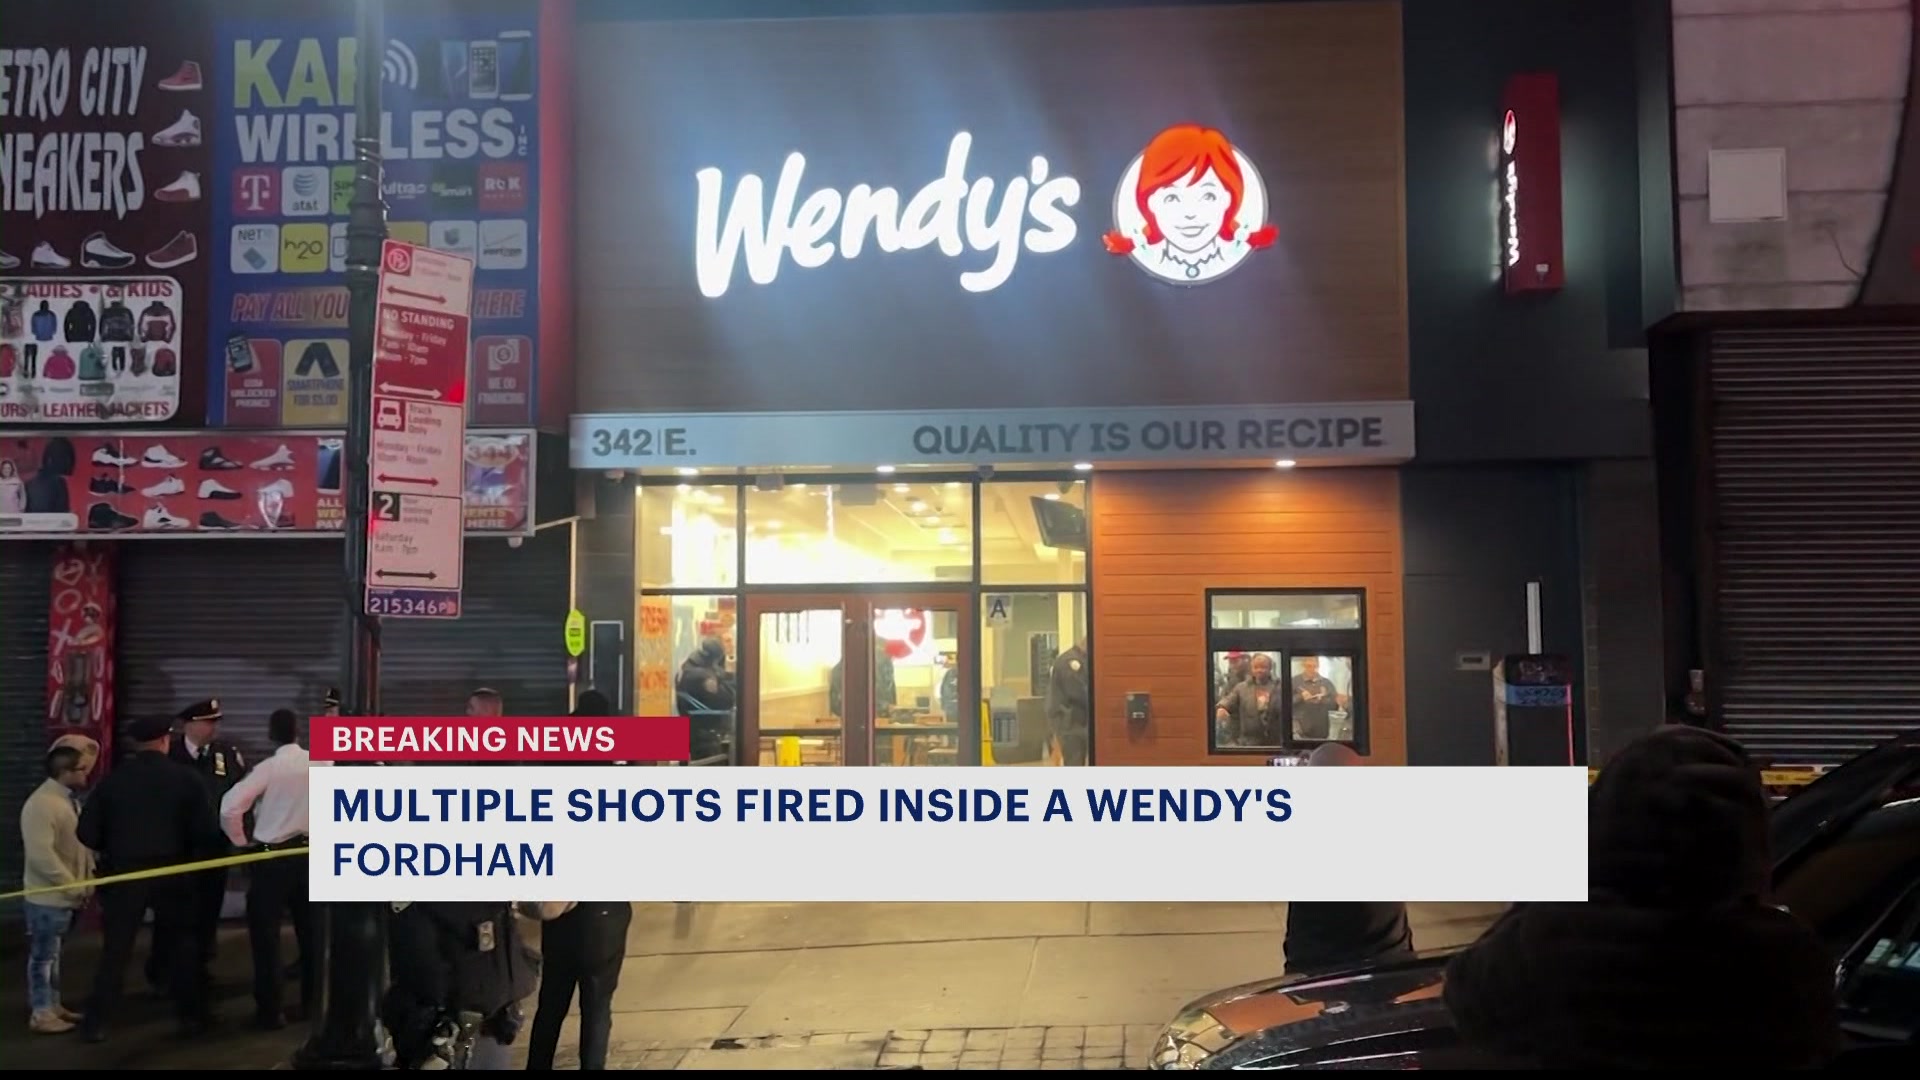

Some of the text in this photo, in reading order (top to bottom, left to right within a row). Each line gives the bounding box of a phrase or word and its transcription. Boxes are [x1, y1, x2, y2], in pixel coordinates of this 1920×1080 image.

[80, 46, 147, 117] CITY
[696, 131, 1080, 298] Wendy's
[128, 281, 173, 297] KIDS
[313, 292, 351, 320] YOU
[382, 308, 455, 330] NO STANDING
[43, 401, 106, 418] LEATHE
[591, 428, 653, 457] 342
[912, 417, 1383, 455] QUALITY IS OUR RECIPE
[378, 494, 394, 519] 2
[990, 599, 1006, 618] A
